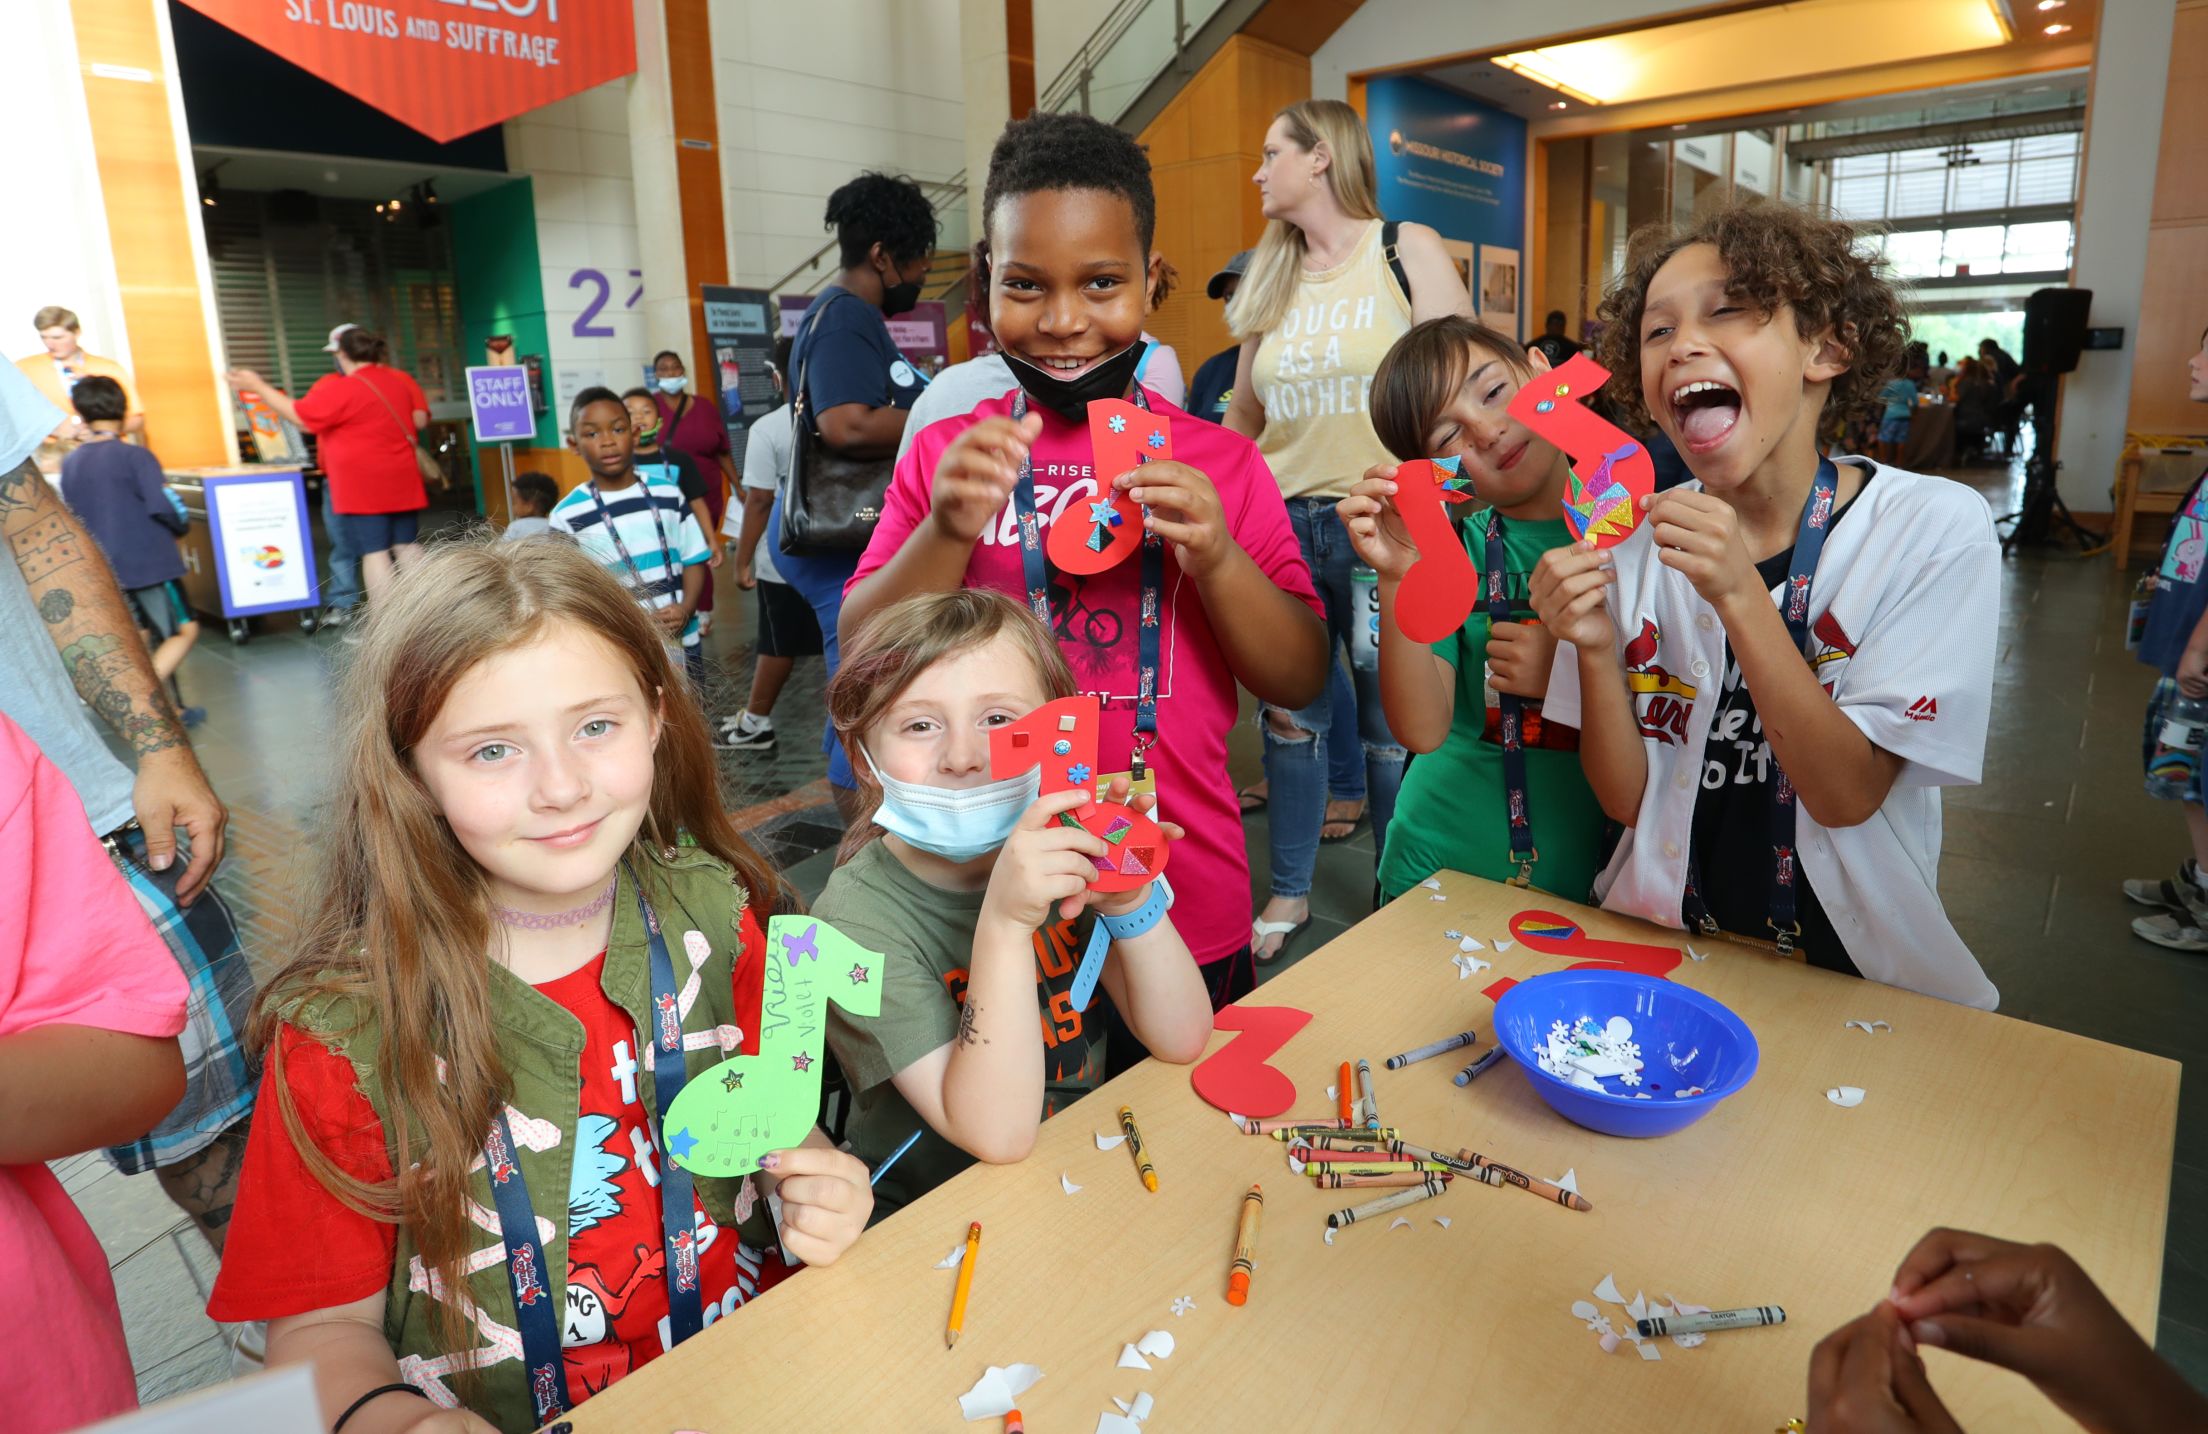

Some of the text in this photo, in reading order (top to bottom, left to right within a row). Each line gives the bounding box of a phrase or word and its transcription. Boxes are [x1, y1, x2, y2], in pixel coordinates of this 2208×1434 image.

[285, 0, 320, 25] ST.
[329, 2, 399, 39] LOUIS
[405, 16, 440, 42] AND
[446, 21, 560, 68] SUFFRAGE
[569, 268, 615, 337] 2
[1283, 296, 1376, 340] OUGH
[1276, 335, 1341, 376] AS A
[475, 377, 522, 392] STAFF
[475, 391, 526, 409] ONLY
[1048, 464, 1091, 477] RISE
[1434, 1152, 1470, 1168] Crayola
[1710, 1311, 1737, 1320] CRAYON
